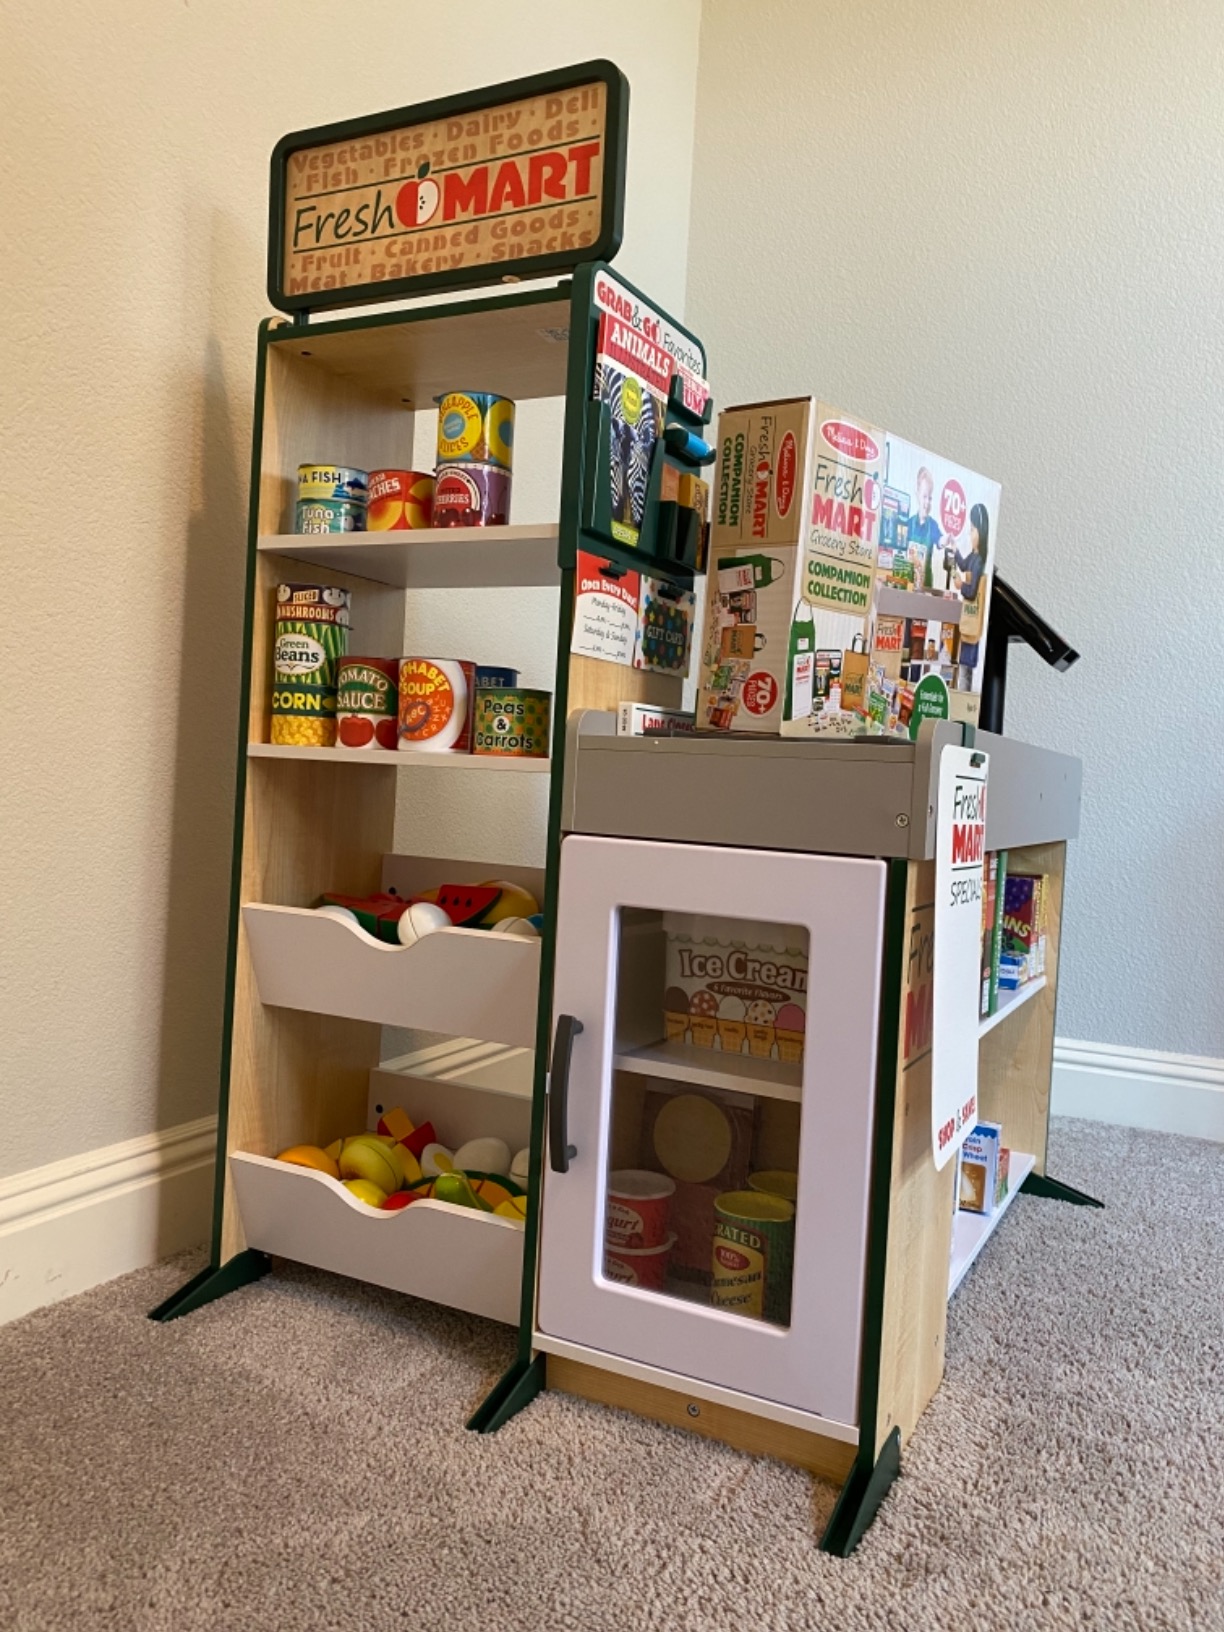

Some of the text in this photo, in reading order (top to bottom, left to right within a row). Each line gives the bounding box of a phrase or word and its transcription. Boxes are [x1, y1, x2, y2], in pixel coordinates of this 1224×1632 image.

[293, 88, 599, 174] Vegetables Dairy Deli
[306, 119, 579, 193] Fish Frozen Foods
[293, 141, 600, 248] Fresh MART
[301, 209, 580, 273] Fruit Canned Goods
[289, 231, 592, 295] Meat Bakery Snacks
[597, 281, 633, 322] GRAB
[663, 332, 701, 375] Favorites
[610, 321, 670, 379] ANIMALS
[311, 470, 341, 484] FISH
[718, 437, 733, 525] COLLECTION
[729, 433, 745, 527] COMPANION
[752, 415, 772, 538] Fresh MART
[814, 463, 863, 505] Fresh
[302, 505, 334, 519] Tuna
[744, 484, 754, 514] Store
[811, 493, 876, 542] MART
[810, 530, 873, 560] Grocery Store
[581, 577, 601, 591] Open
[602, 579, 621, 597] Every
[808, 560, 871, 589] COMPANION
[807, 580, 868, 608] COLLECTION
[280, 637, 309, 650] Green
[647, 624, 685, 647] GIFT CARD
[275, 647, 320, 664] Beans
[339, 667, 388, 691] OMATO
[400, 682, 435, 695] SOUP
[273, 691, 321, 711] CORN
[484, 699, 525, 716] Peas
[496, 717, 507, 730] &
[642, 714, 665, 730] Lane
[476, 731, 533, 749] Carrots
[678, 948, 724, 979] Ice
[715, 1221, 761, 1249] RATED
